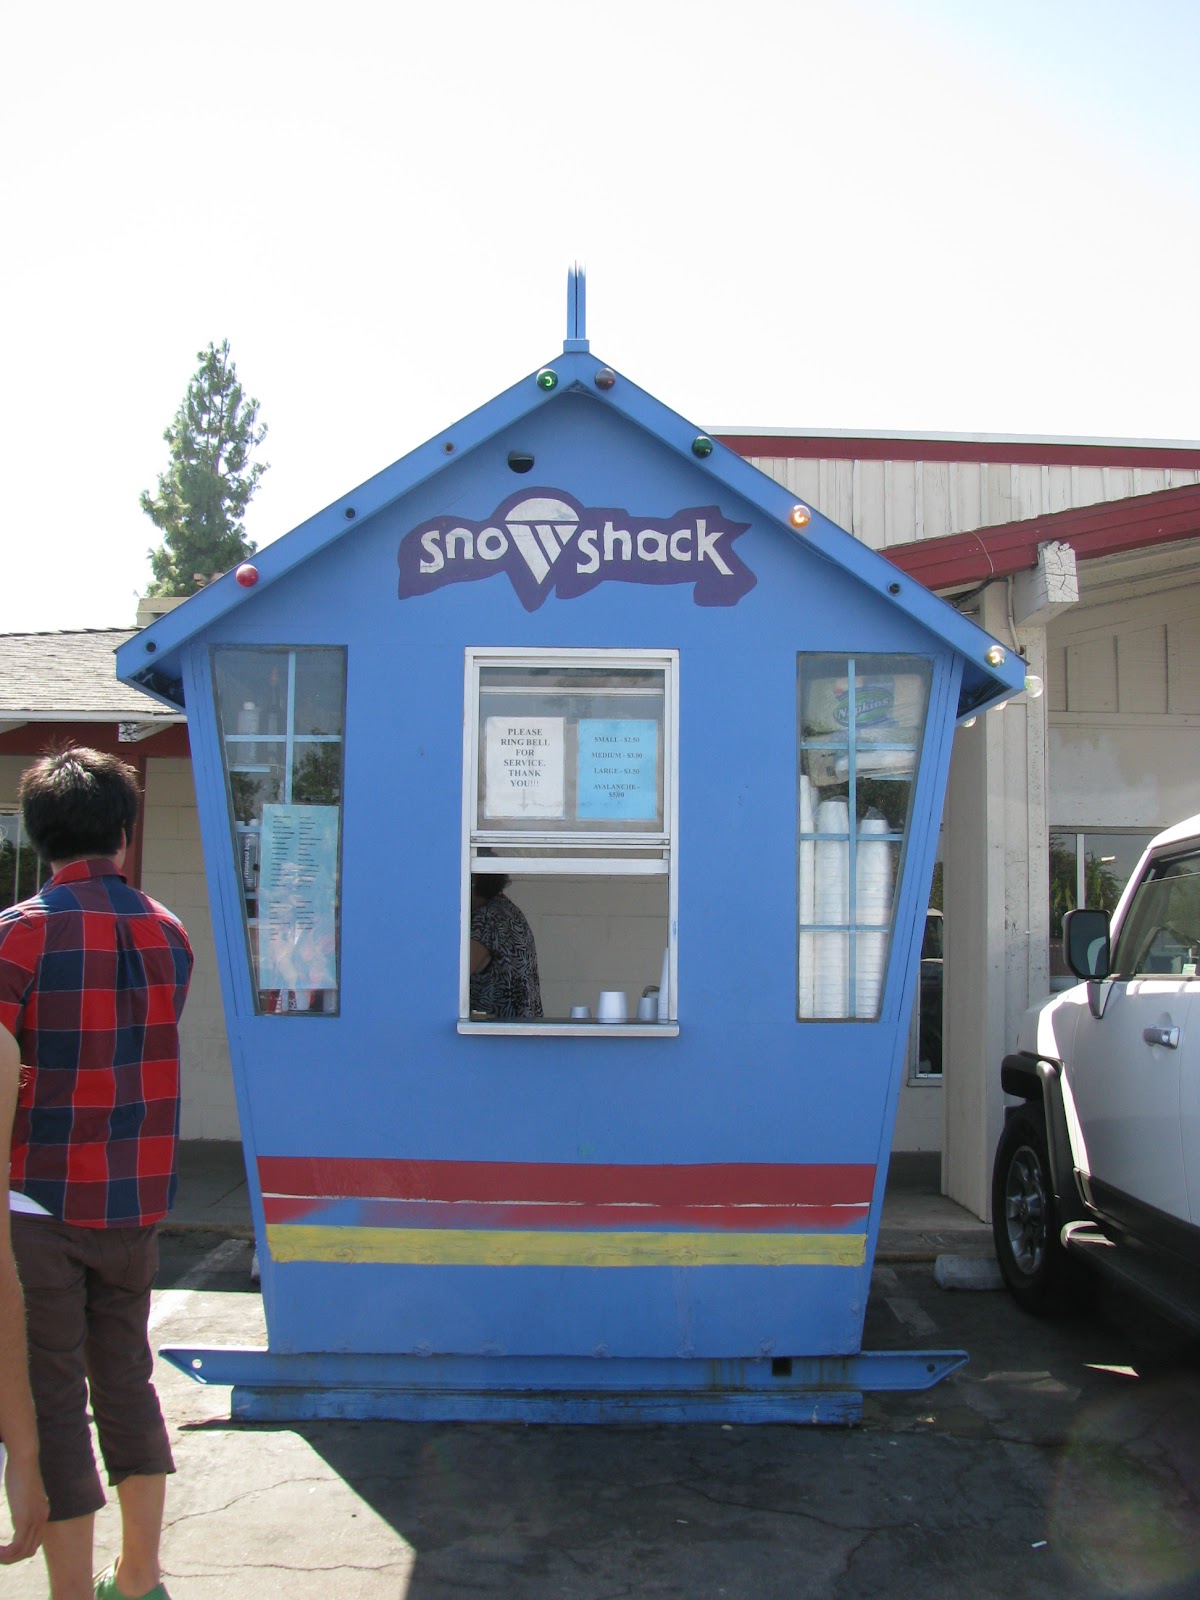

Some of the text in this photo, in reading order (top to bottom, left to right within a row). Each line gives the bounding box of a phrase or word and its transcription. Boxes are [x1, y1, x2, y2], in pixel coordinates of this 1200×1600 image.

[838, 697, 889, 719] Npkins
[508, 728, 543, 736] PLEASE
[501, 738, 551, 746] RING BELL
[515, 748, 535, 757] FOR
[503, 759, 546, 767] SERVICE.
[508, 769, 542, 777] THANK
[510, 779, 539, 788] YOU!!!
